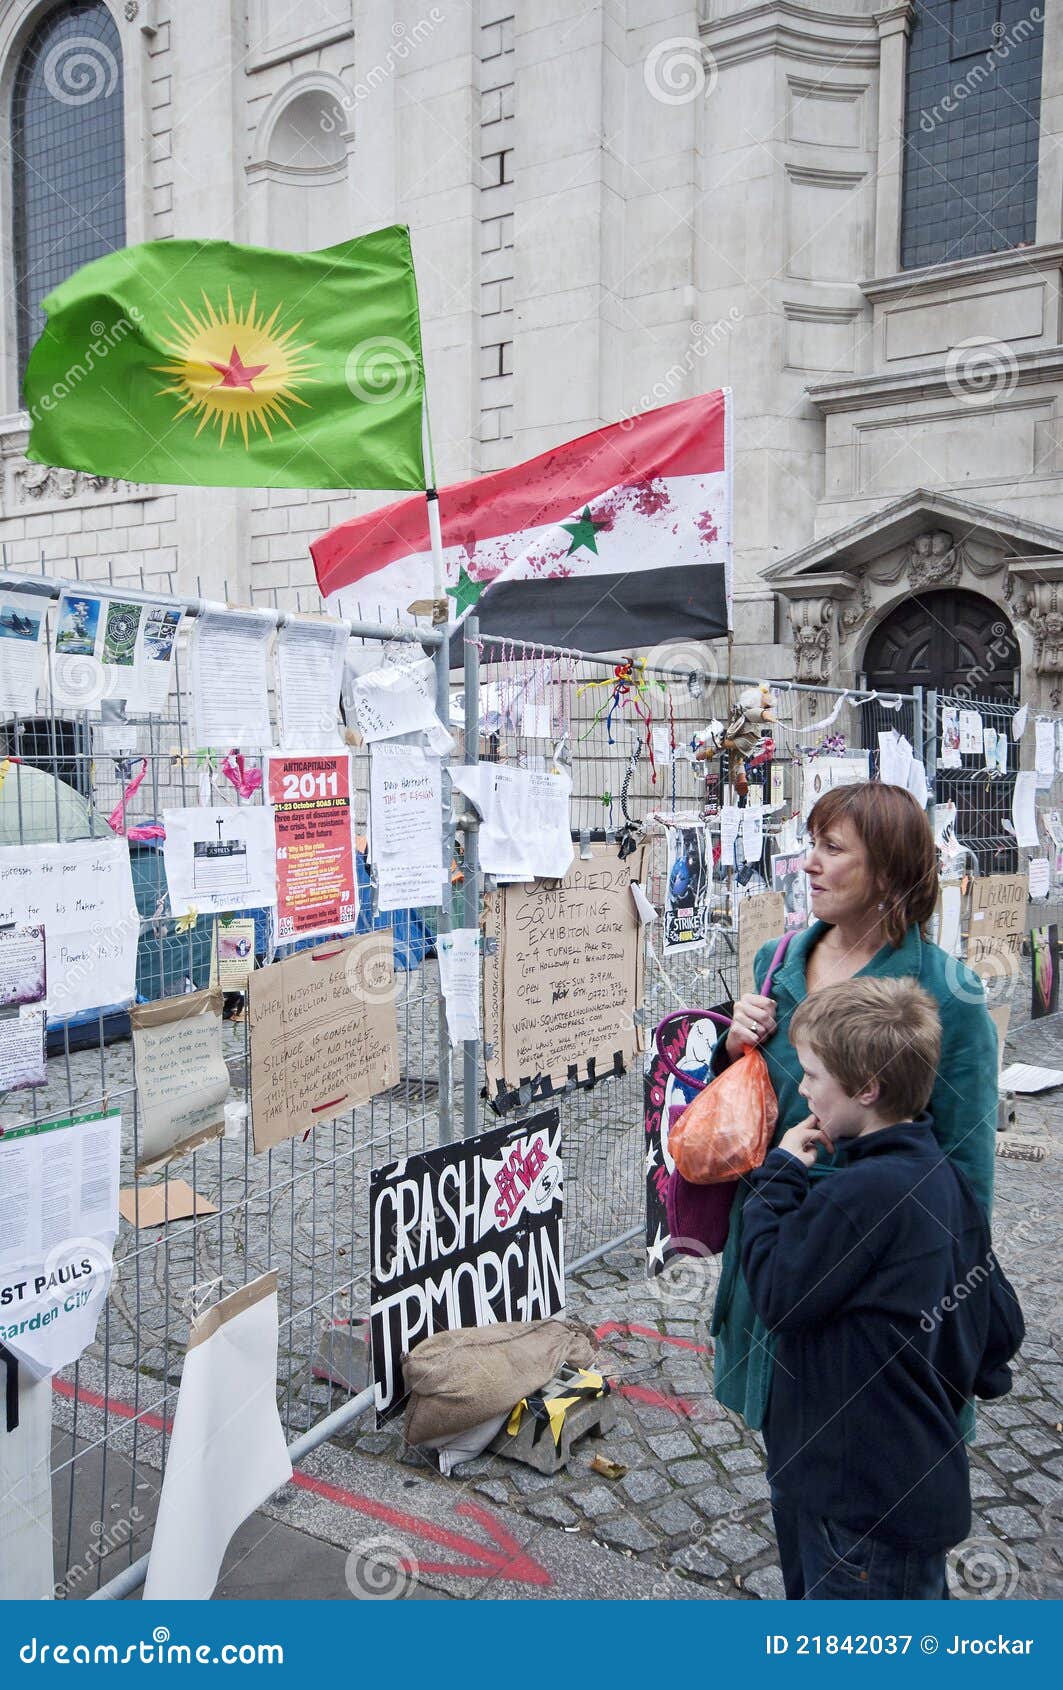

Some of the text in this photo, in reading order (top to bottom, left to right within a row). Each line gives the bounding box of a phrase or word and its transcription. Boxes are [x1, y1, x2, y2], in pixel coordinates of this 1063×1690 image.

[283, 760, 337, 772] ANTICAPITALISM
[282, 771, 338, 800] 2011
[293, 801, 315, 810] October
[516, 901, 611, 932] SQUATTING
[673, 915, 701, 931] STRIKE
[517, 984, 540, 998] OPEN
[263, 1040, 305, 1073] SILENCE
[535, 1049, 588, 1072] NETWORK
[494, 1140, 525, 1195] BUY
[494, 1137, 549, 1228] SILVER
[374, 1155, 482, 1284] CRASH
[0, 1258, 93, 1305] ST PAULS
[63, 1288, 94, 1311] City
[370, 1218, 566, 1412] JPMORGAN
